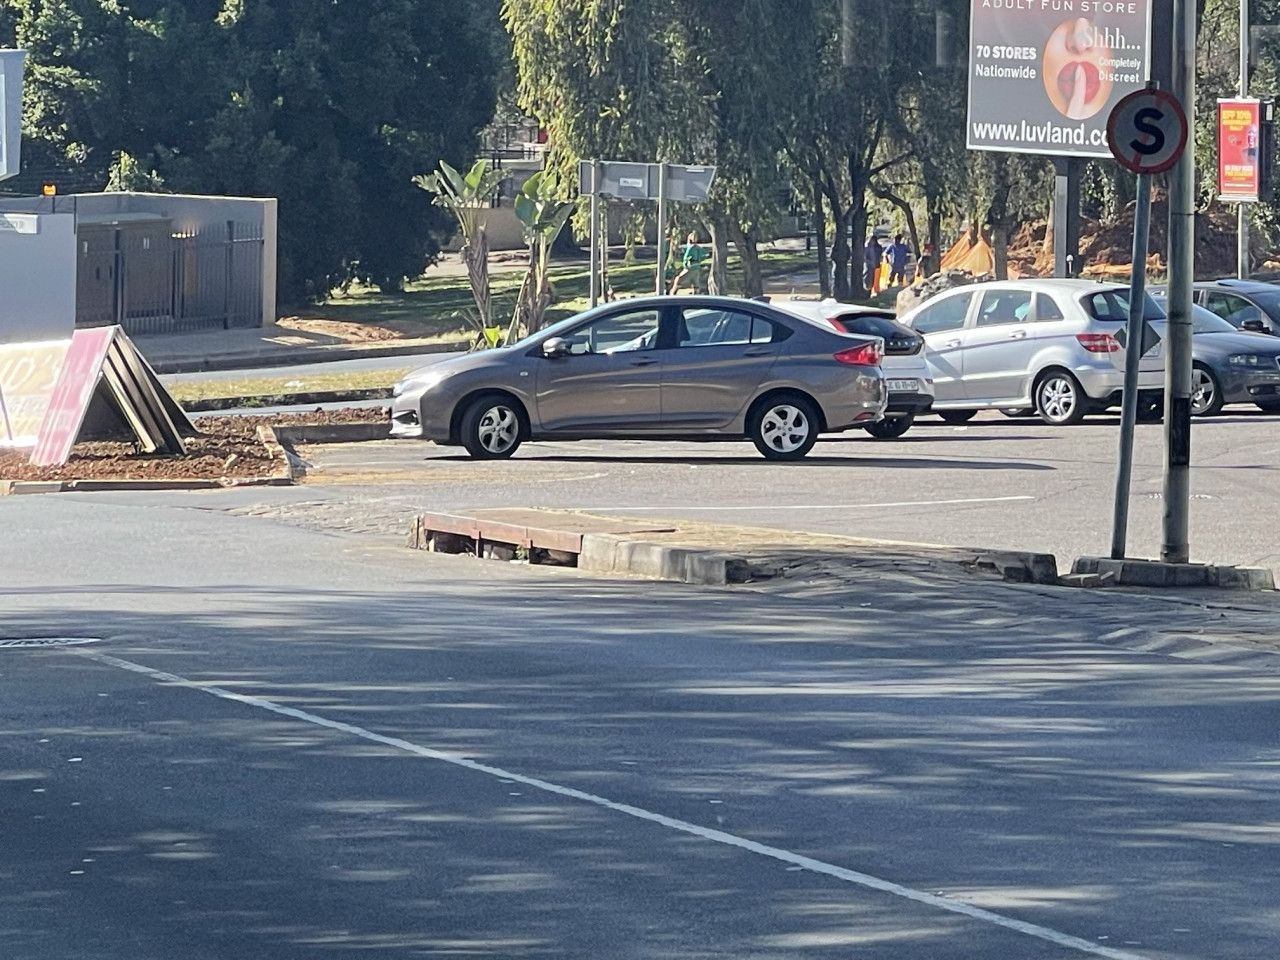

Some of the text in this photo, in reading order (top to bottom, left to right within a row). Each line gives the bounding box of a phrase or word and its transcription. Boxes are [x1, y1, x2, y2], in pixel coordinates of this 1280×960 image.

[1041, 0, 1074, 12] FUN
[1081, 1, 1137, 14] STORE
[976, 45, 1037, 61] 70 STORES
[1099, 56, 1142, 70] Completely
[975, 63, 1037, 79] Nationwide
[1098, 72, 1140, 84] Discreet
